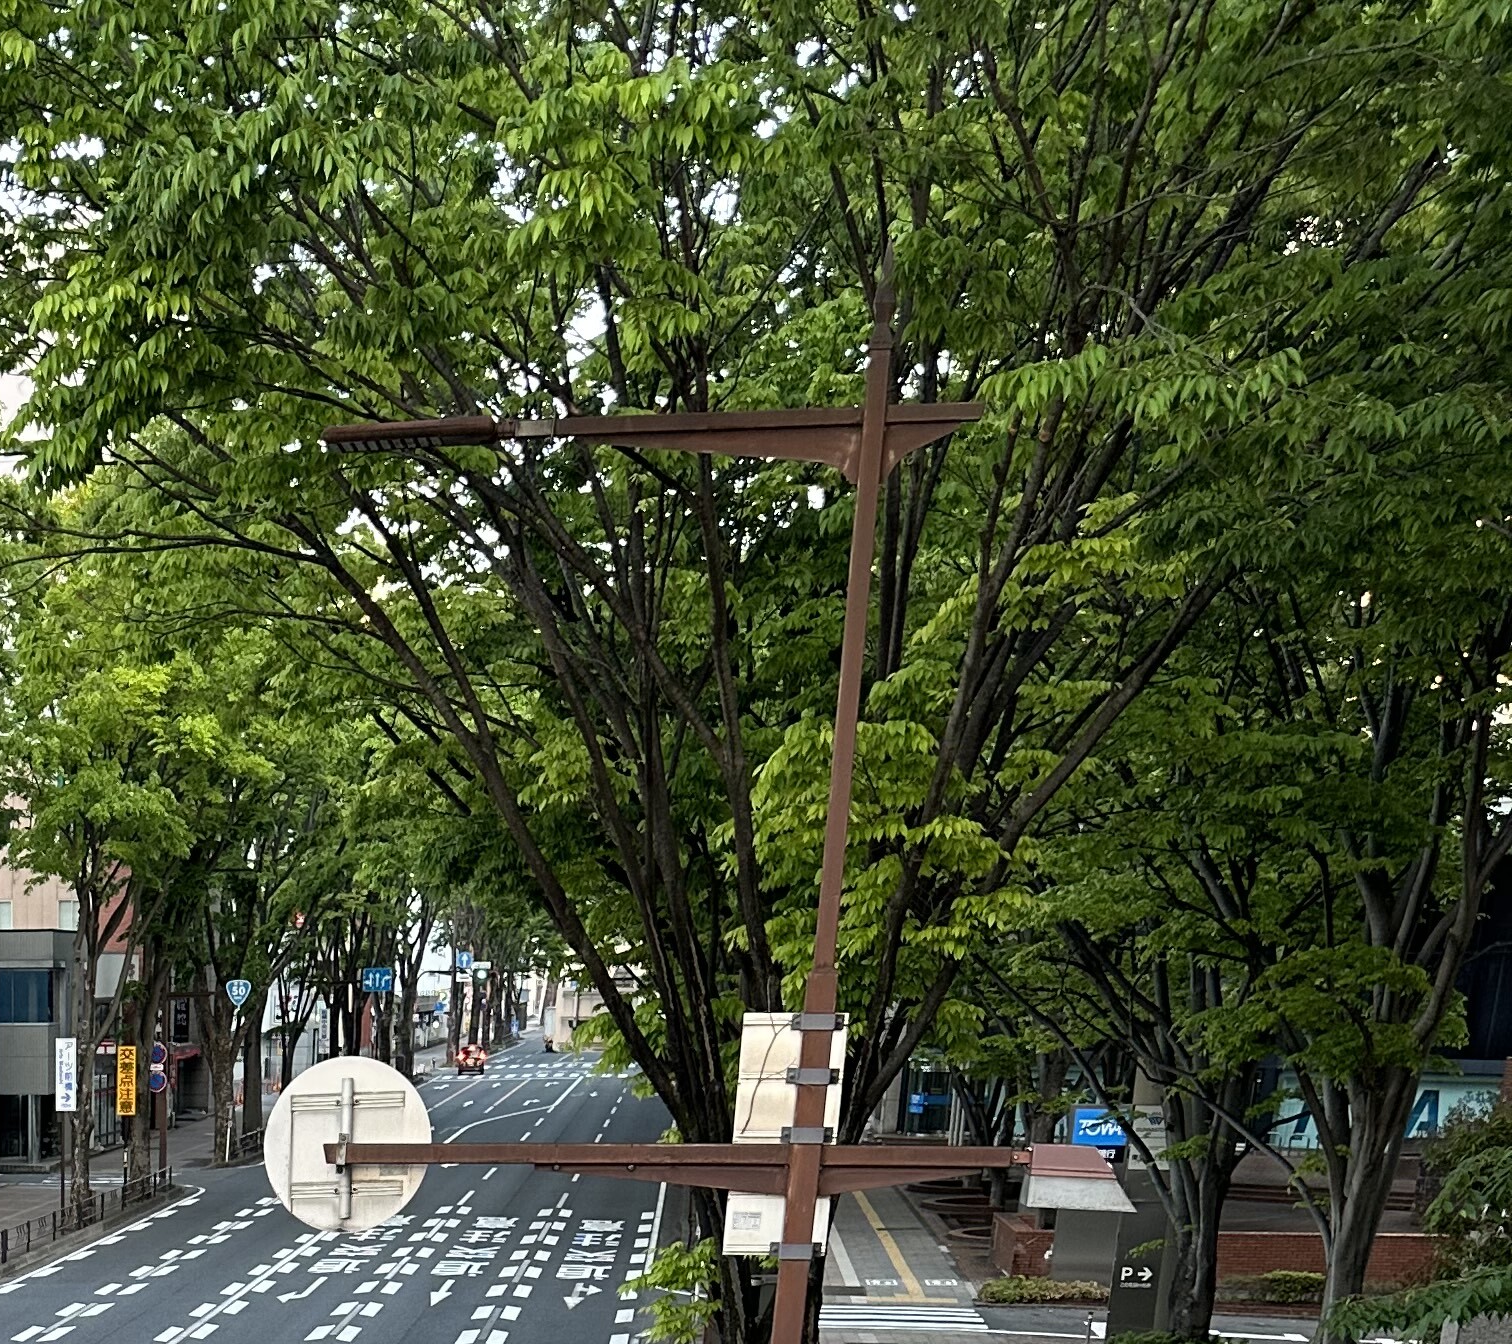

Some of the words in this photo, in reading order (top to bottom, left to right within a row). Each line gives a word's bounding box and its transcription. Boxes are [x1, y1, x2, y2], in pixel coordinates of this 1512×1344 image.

[232, 986, 246, 996] 50
[119, 1047, 135, 1114] 交差点注意
[1120, 1265, 1134, 1281] P
